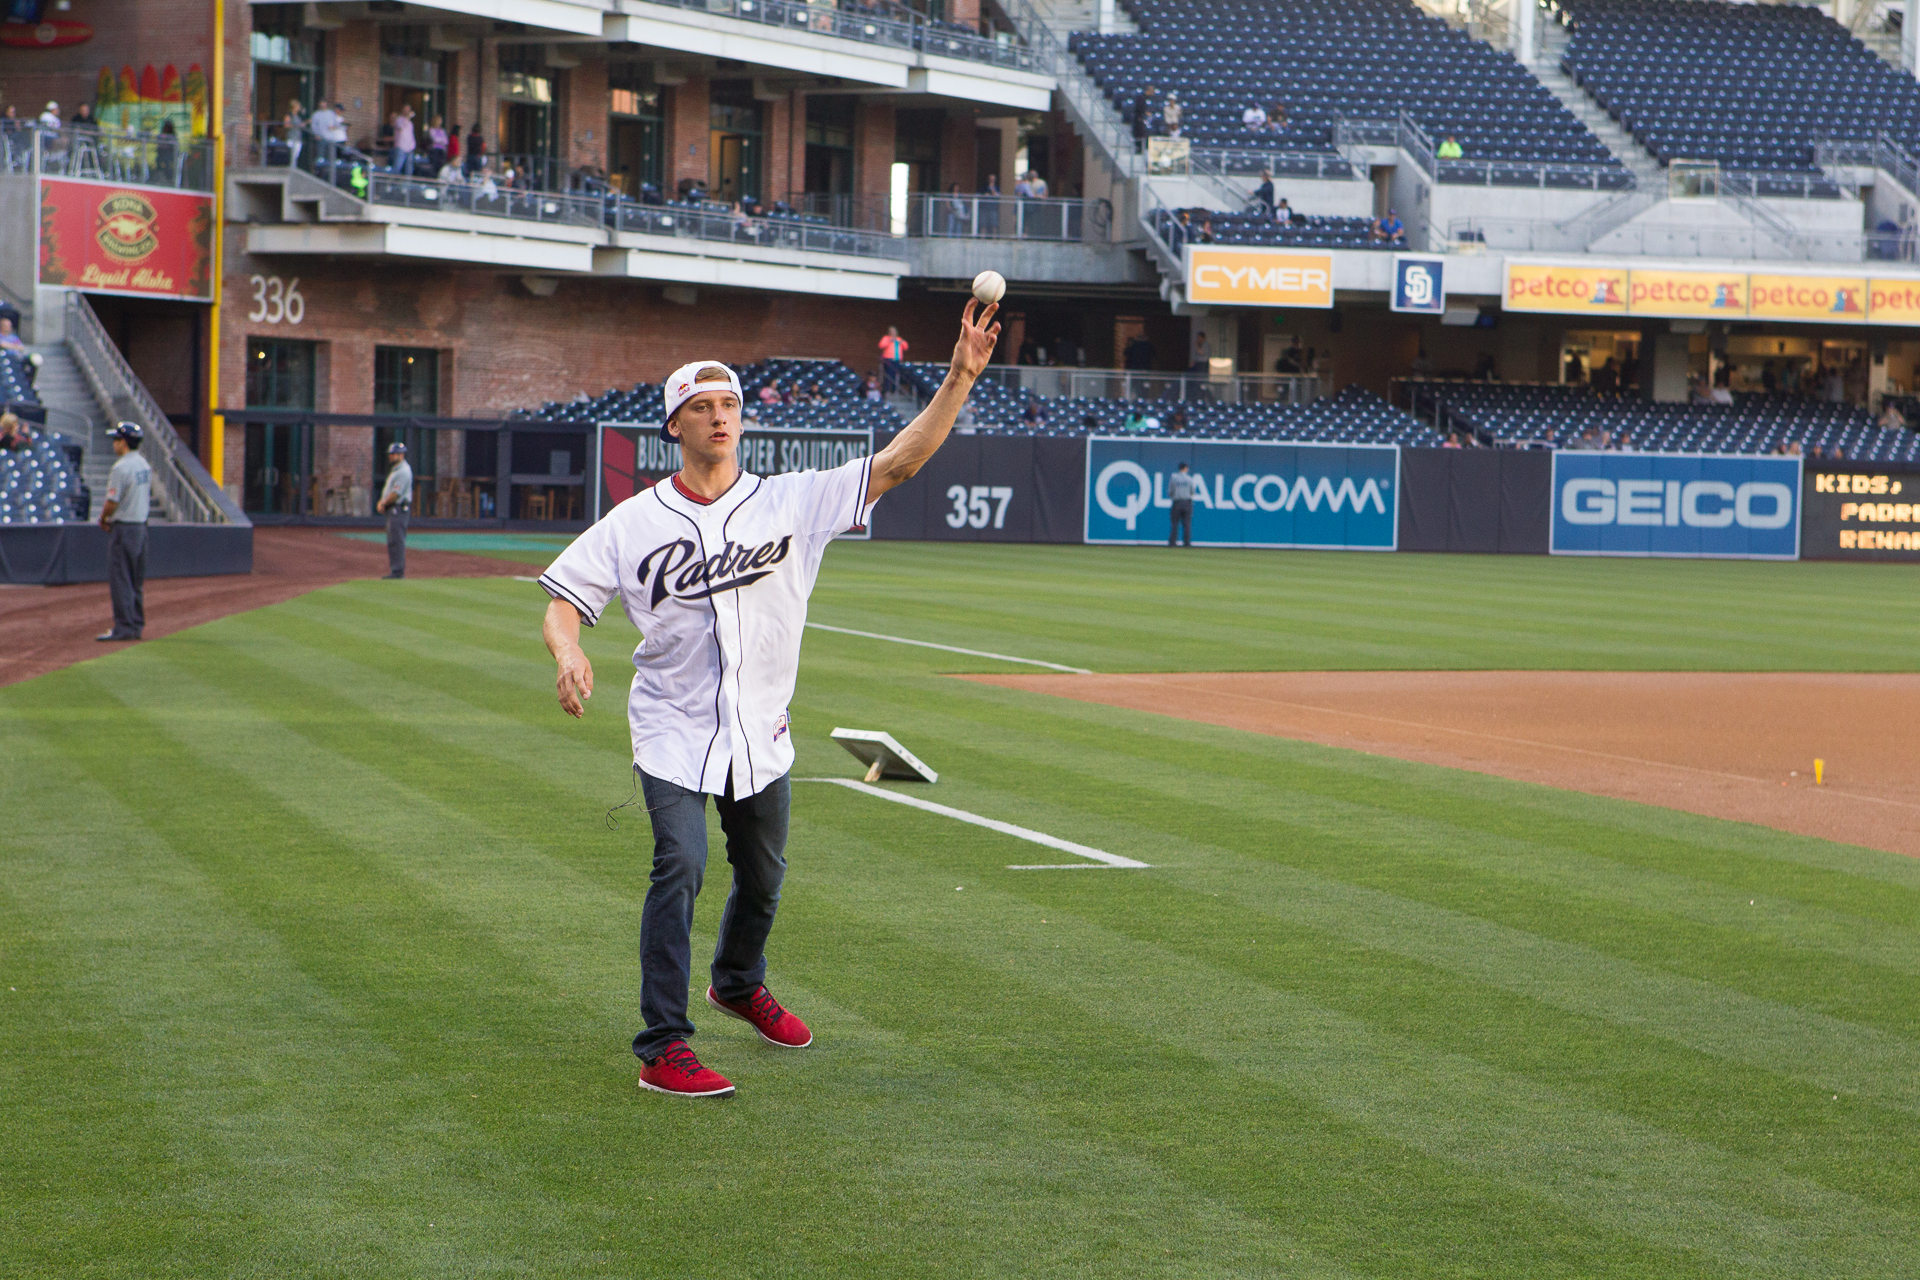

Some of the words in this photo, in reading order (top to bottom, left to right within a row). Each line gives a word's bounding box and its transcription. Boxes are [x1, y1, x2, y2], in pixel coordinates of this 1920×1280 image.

[81, 263, 130, 289] Liquid
[131, 267, 174, 290] Aloha
[1195, 265, 1327, 291] CYMER
[1510, 274, 1589, 300] petco
[249, 274, 305, 325] 336
[1632, 279, 1709, 304] petco
[1752, 284, 1829, 310] petco
[637, 434, 684, 471] BUSIN
[737, 437, 775, 473] PIER
[1816, 473, 1902, 495] KIDS,
[945, 484, 1014, 529] 357
[1562, 478, 1793, 529] GEICO
[637, 533, 793, 612] Padres
